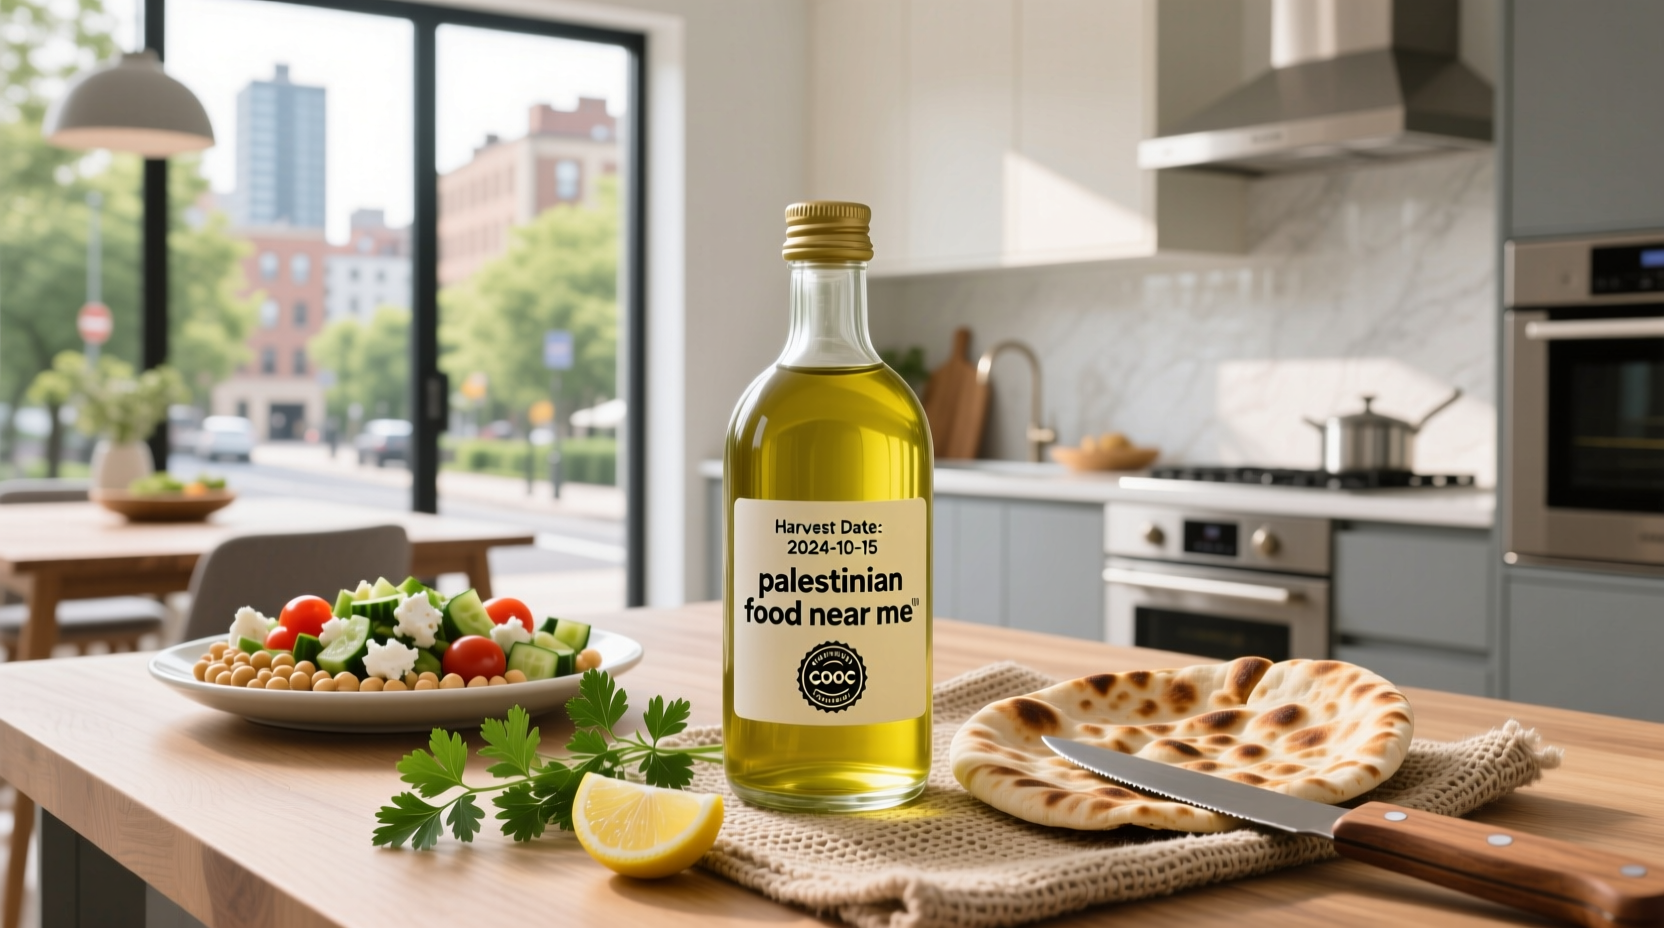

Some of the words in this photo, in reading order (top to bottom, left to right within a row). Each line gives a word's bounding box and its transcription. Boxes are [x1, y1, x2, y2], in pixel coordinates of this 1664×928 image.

[775, 518, 837, 535] Harvest
[840, 519, 883, 535] Date:
[787, 539, 878, 556] 2024-10-15
[758, 566, 903, 599] palestinian
[744, 597, 802, 626] food
[809, 605, 871, 626] near
